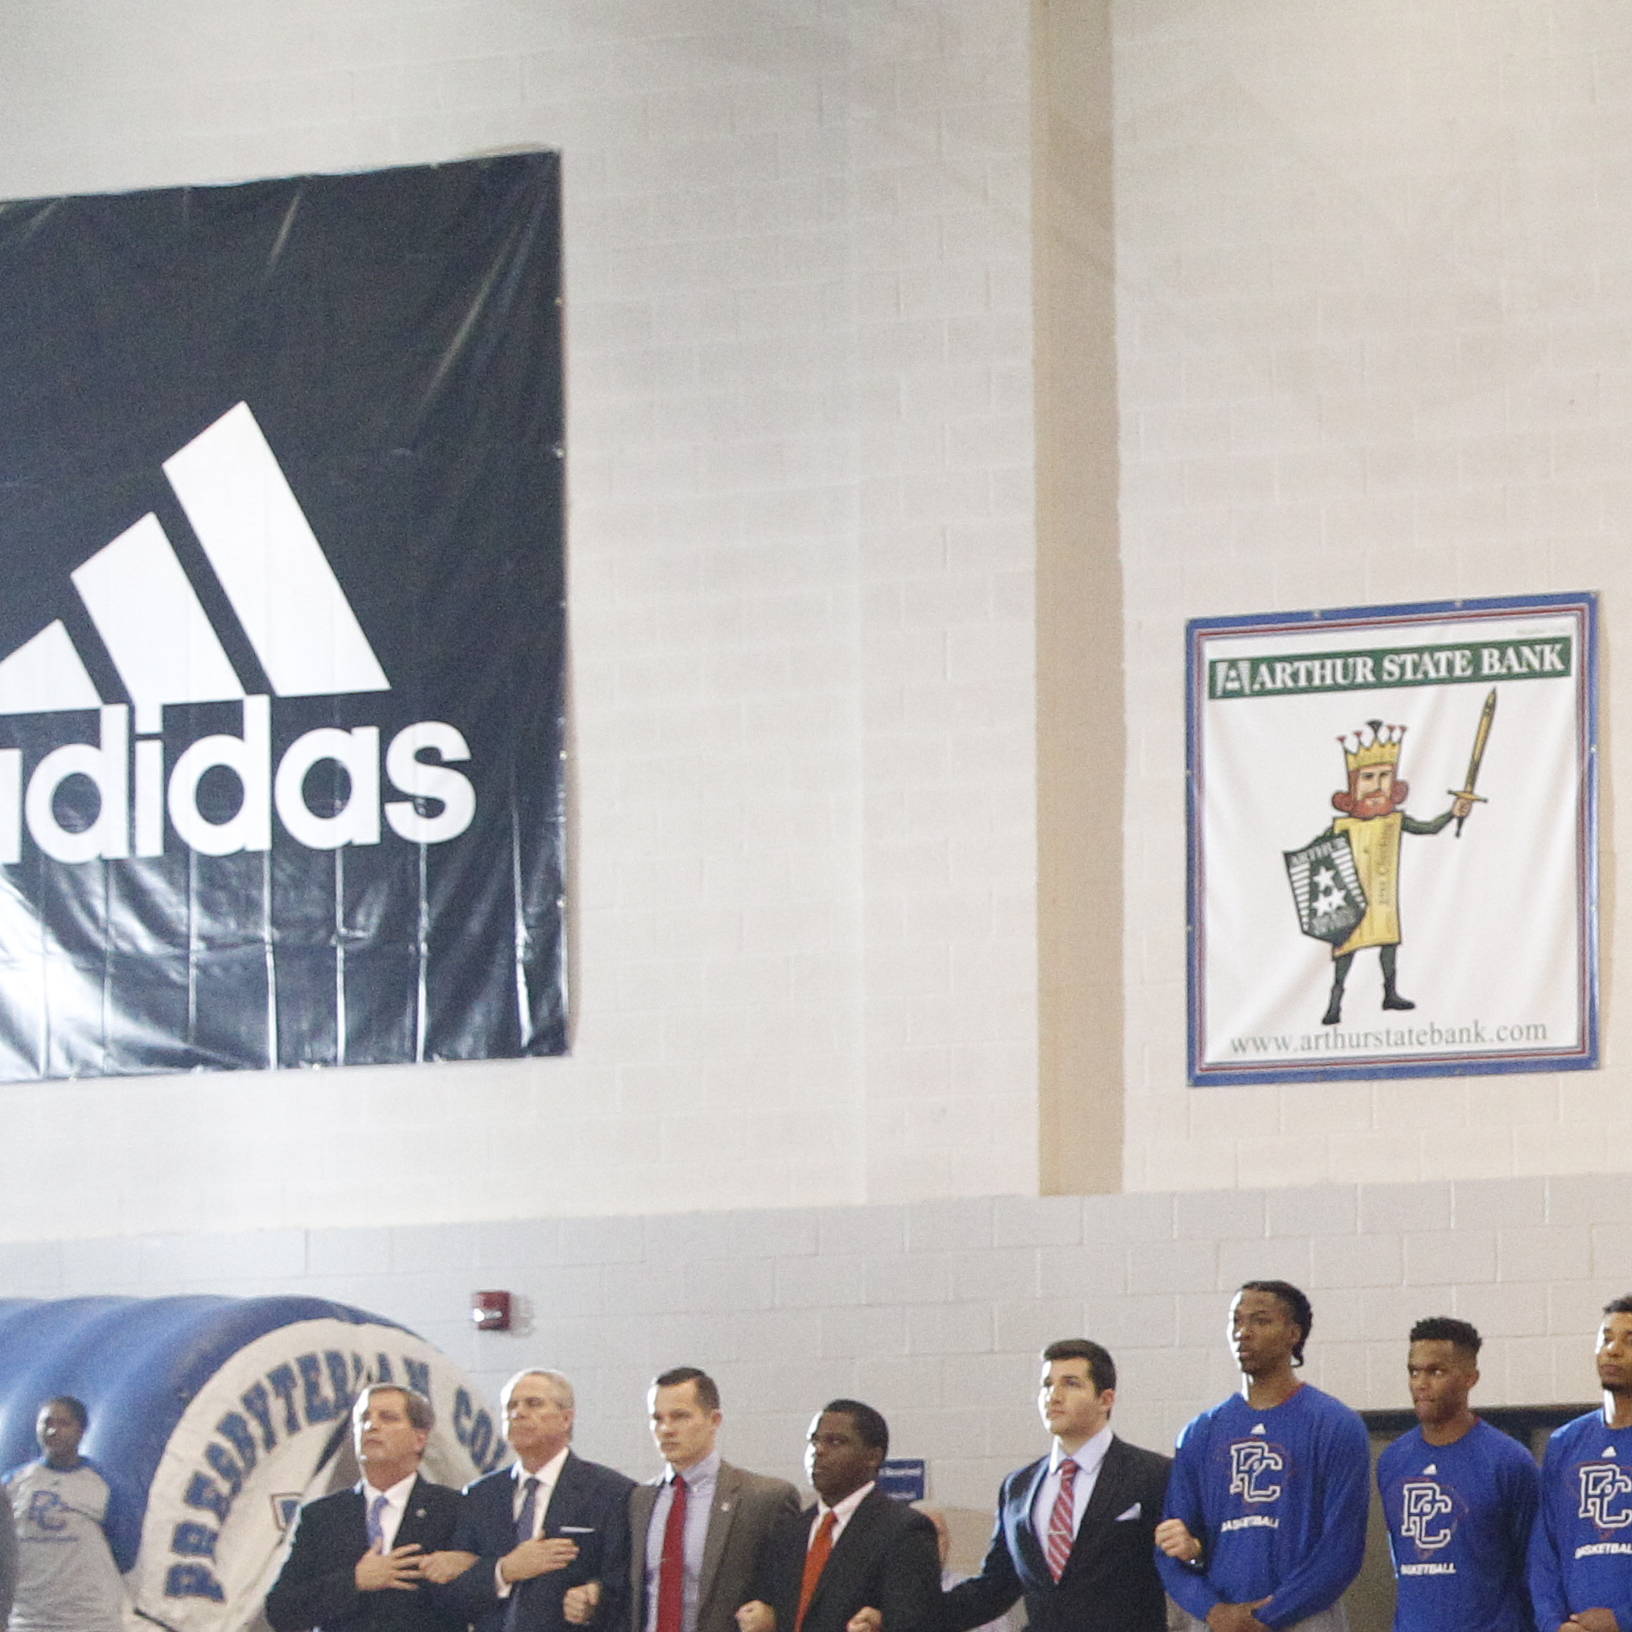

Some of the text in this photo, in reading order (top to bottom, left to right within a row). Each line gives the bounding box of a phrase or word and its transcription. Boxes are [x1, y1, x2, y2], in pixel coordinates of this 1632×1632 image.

[1253, 654, 1375, 691] ARTHUR
[1382, 649, 1474, 683] STATE
[1481, 643, 1566, 675] BANK
[0, 694, 476, 865] didas
[1230, 1020, 1548, 1056] www.arthurstatebank.com
[1229, 1441, 1283, 1503] PC
[1401, 1482, 1453, 1549] PC
